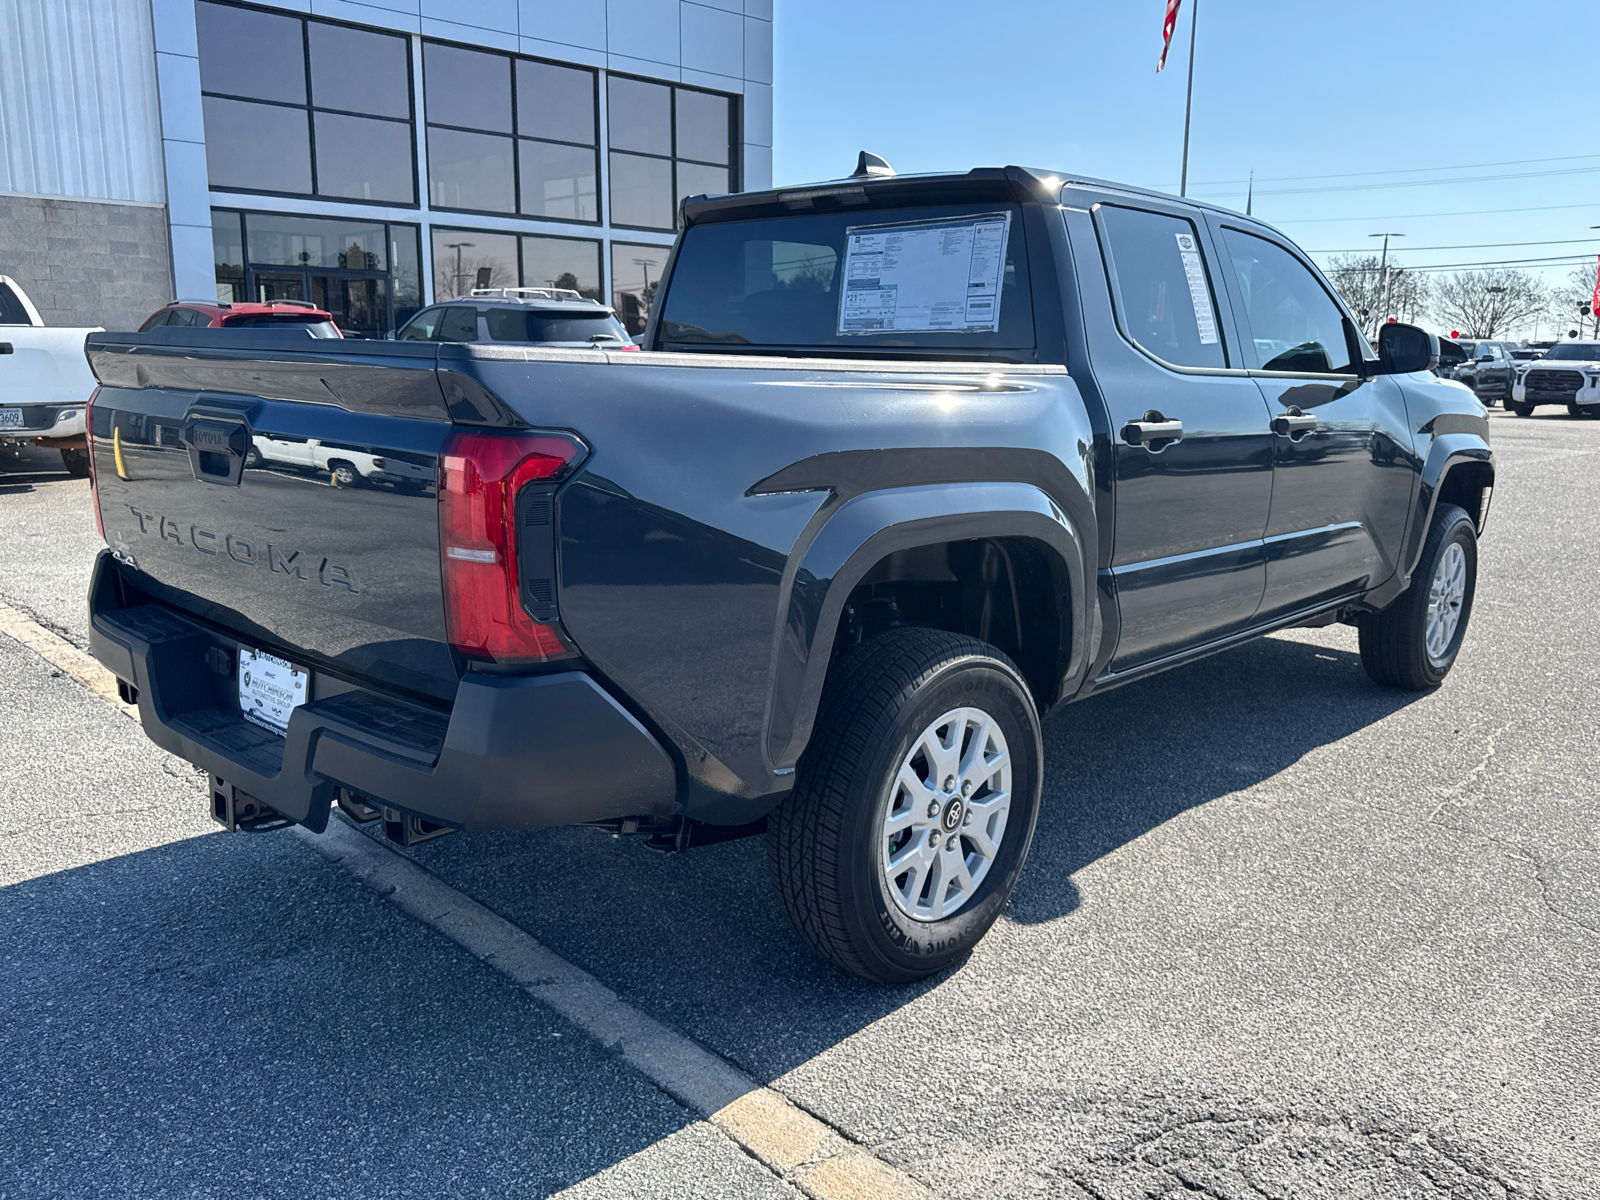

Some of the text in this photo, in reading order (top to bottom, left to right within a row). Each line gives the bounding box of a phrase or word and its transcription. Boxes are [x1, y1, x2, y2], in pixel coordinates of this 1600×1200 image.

[194, 430, 223, 446] TOYOTA
[130, 505, 360, 594] TACOMA
[264, 670, 276, 680] GMC
[251, 677, 294, 702] HUTCHINSON
[252, 688, 276, 704] AUTOMOTIVE
[879, 911, 901, 940] HLT
